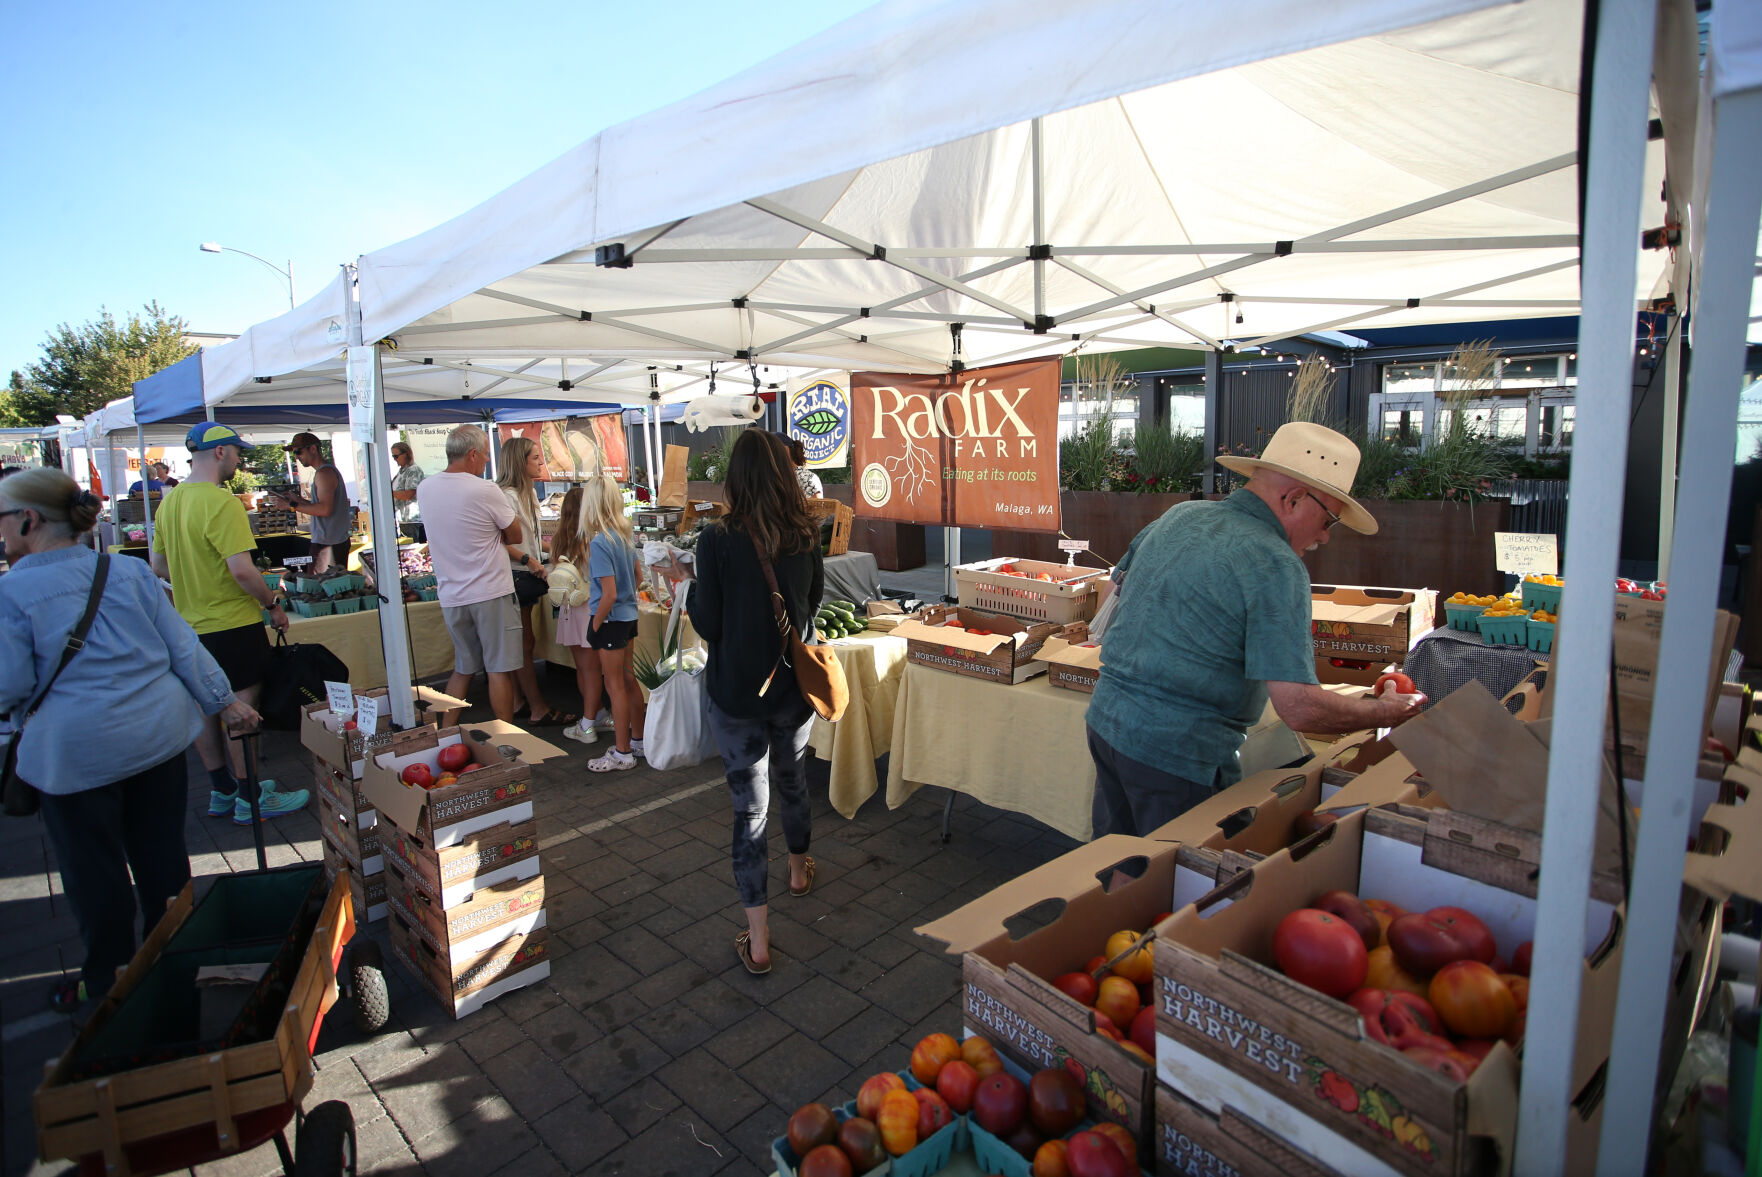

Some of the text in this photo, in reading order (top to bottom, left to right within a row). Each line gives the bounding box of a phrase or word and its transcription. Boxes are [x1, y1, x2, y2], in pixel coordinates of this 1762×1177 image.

[870, 378, 1035, 439] Radix
[792, 427, 842, 450] ORGANIC
[954, 439, 1037, 458] FARM
[943, 467, 1037, 482] Eating at its roots
[995, 503, 1053, 515] Malaga, WA
[1502, 534, 1540, 543] CHERRY
[1508, 544, 1552, 554] TOMATOES
[1331, 641, 1391, 654] HARVEST
[915, 651, 1001, 677] NORTHWEST HARVEST
[1059, 672, 1099, 687] NORTHW
[435, 789, 489, 810] NORTHWEST
[436, 796, 490, 819] HARVEST
[444, 846, 497, 869] NORTHWEST
[445, 854, 497, 879] HARVEST
[451, 901, 505, 927] NORTHWEST
[452, 909, 504, 935] HARVEST
[457, 954, 508, 980] NORTHWEST
[458, 961, 509, 990] HARVEST
[967, 982, 1054, 1048] NORTHWEST
[1163, 976, 1302, 1059] NORTHWEST
[968, 997, 1053, 1068] HARVEST
[1163, 995, 1302, 1083] HARVEST
